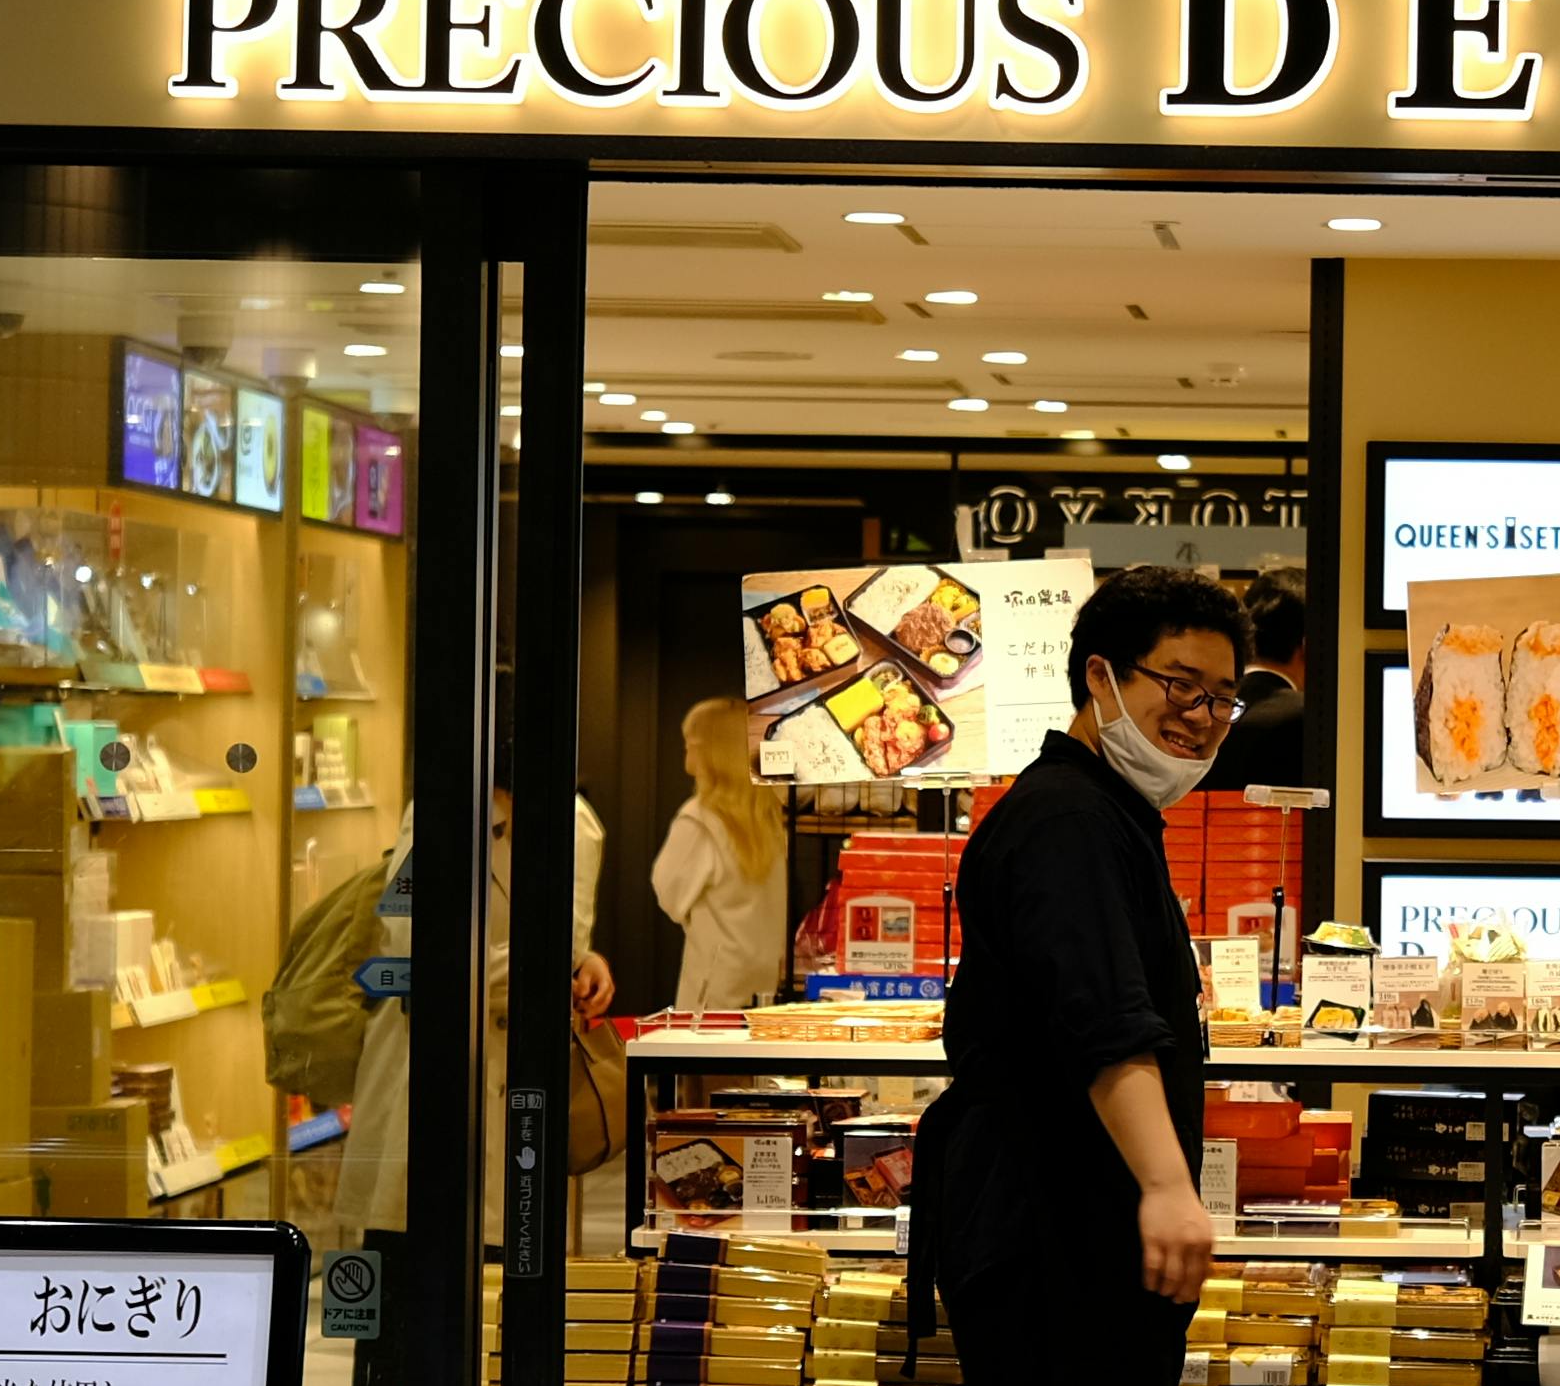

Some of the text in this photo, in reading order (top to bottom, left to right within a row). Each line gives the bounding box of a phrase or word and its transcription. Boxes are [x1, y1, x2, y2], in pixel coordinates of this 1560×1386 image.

[1395, 523, 1499, 549] QUEEN'S
[1007, 640, 1069, 657] こだわり
[1024, 664, 1055, 678] 弁当
[380, 970, 394, 986] 自
[512, 1094, 542, 1110] 自動
[520, 1116, 532, 1141] 手を
[518, 1175, 533, 1275] 近づけてください
[28, 1275, 204, 1339] おにぎり
[323, 1308, 377, 1321] ドアに注意
[331, 1324, 370, 1332] CAUTION
